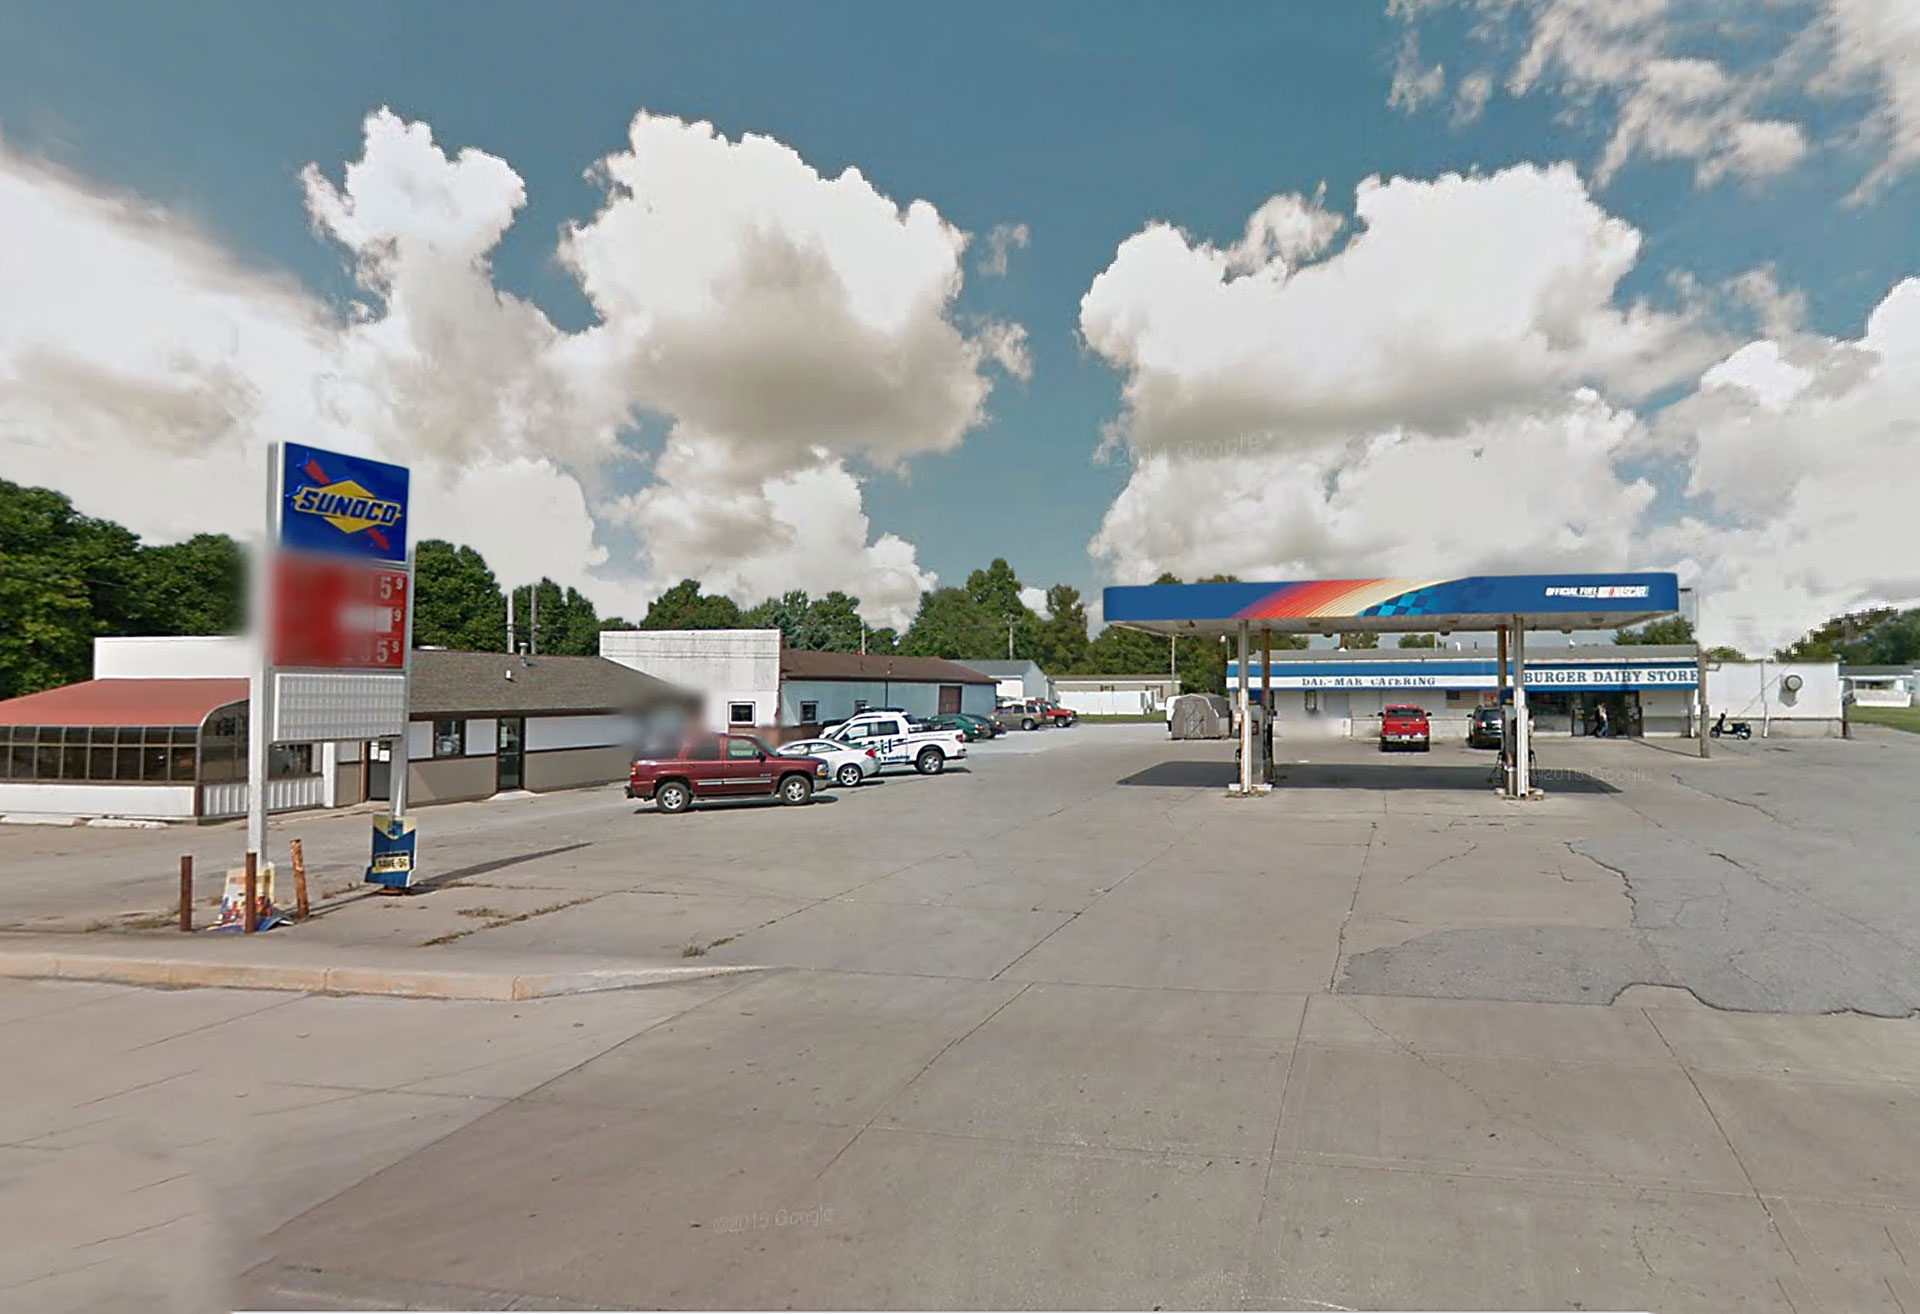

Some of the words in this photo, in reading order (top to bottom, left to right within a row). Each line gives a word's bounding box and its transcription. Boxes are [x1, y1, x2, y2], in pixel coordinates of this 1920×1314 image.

[299, 490, 398, 523] SUNOCO
[1370, 677, 1436, 686] CATERING
[1524, 671, 1587, 683] BURGER
[1593, 670, 1642, 683] DAIRY
[1647, 669, 1698, 682] STORE
